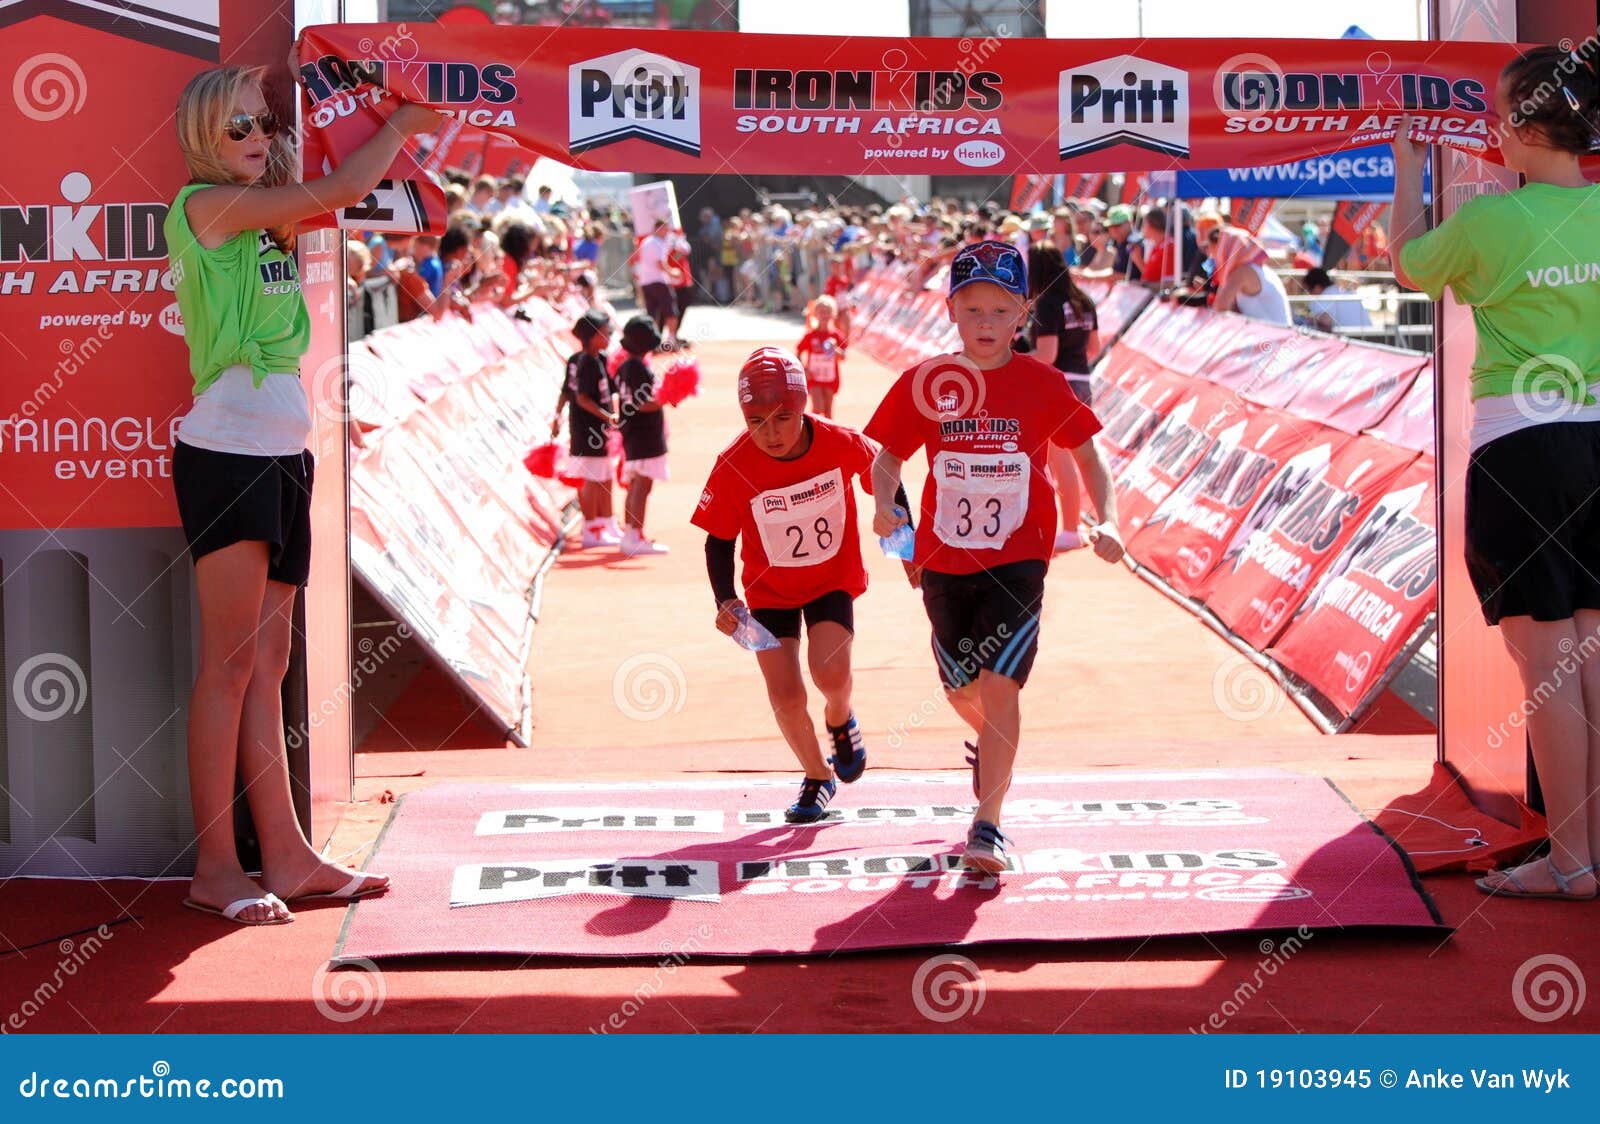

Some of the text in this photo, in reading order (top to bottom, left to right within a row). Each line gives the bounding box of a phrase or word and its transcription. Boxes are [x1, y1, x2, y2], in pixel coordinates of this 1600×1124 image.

[580, 67, 689, 121] Pritt
[734, 69, 1004, 112] IRONKIDS
[1071, 70, 1178, 125] Pritt
[1221, 71, 1488, 113] IRONKIDS
[736, 117, 1003, 136] SOUTH AFRICA
[1223, 116, 1488, 135] SOUTH AFRICA
[1351, 130, 1414, 144] powerd
[1415, 133, 1434, 144] by
[864, 147, 1001, 160] powered by Henkel
[40, 311, 124, 330] powered
[129, 311, 152, 327] by
[940, 417, 1019, 436] IRONKIDS
[55, 454, 171, 480] event
[970, 464, 1022, 473] IRONKIDS
[790, 480, 835, 502] IRONKIDS
[766, 498, 783, 508] Pritt
[955, 498, 1002, 538] 33
[785, 517, 833, 559] 28
[479, 863, 698, 890] Pritt
[1023, 871, 1291, 890] AFRICA
